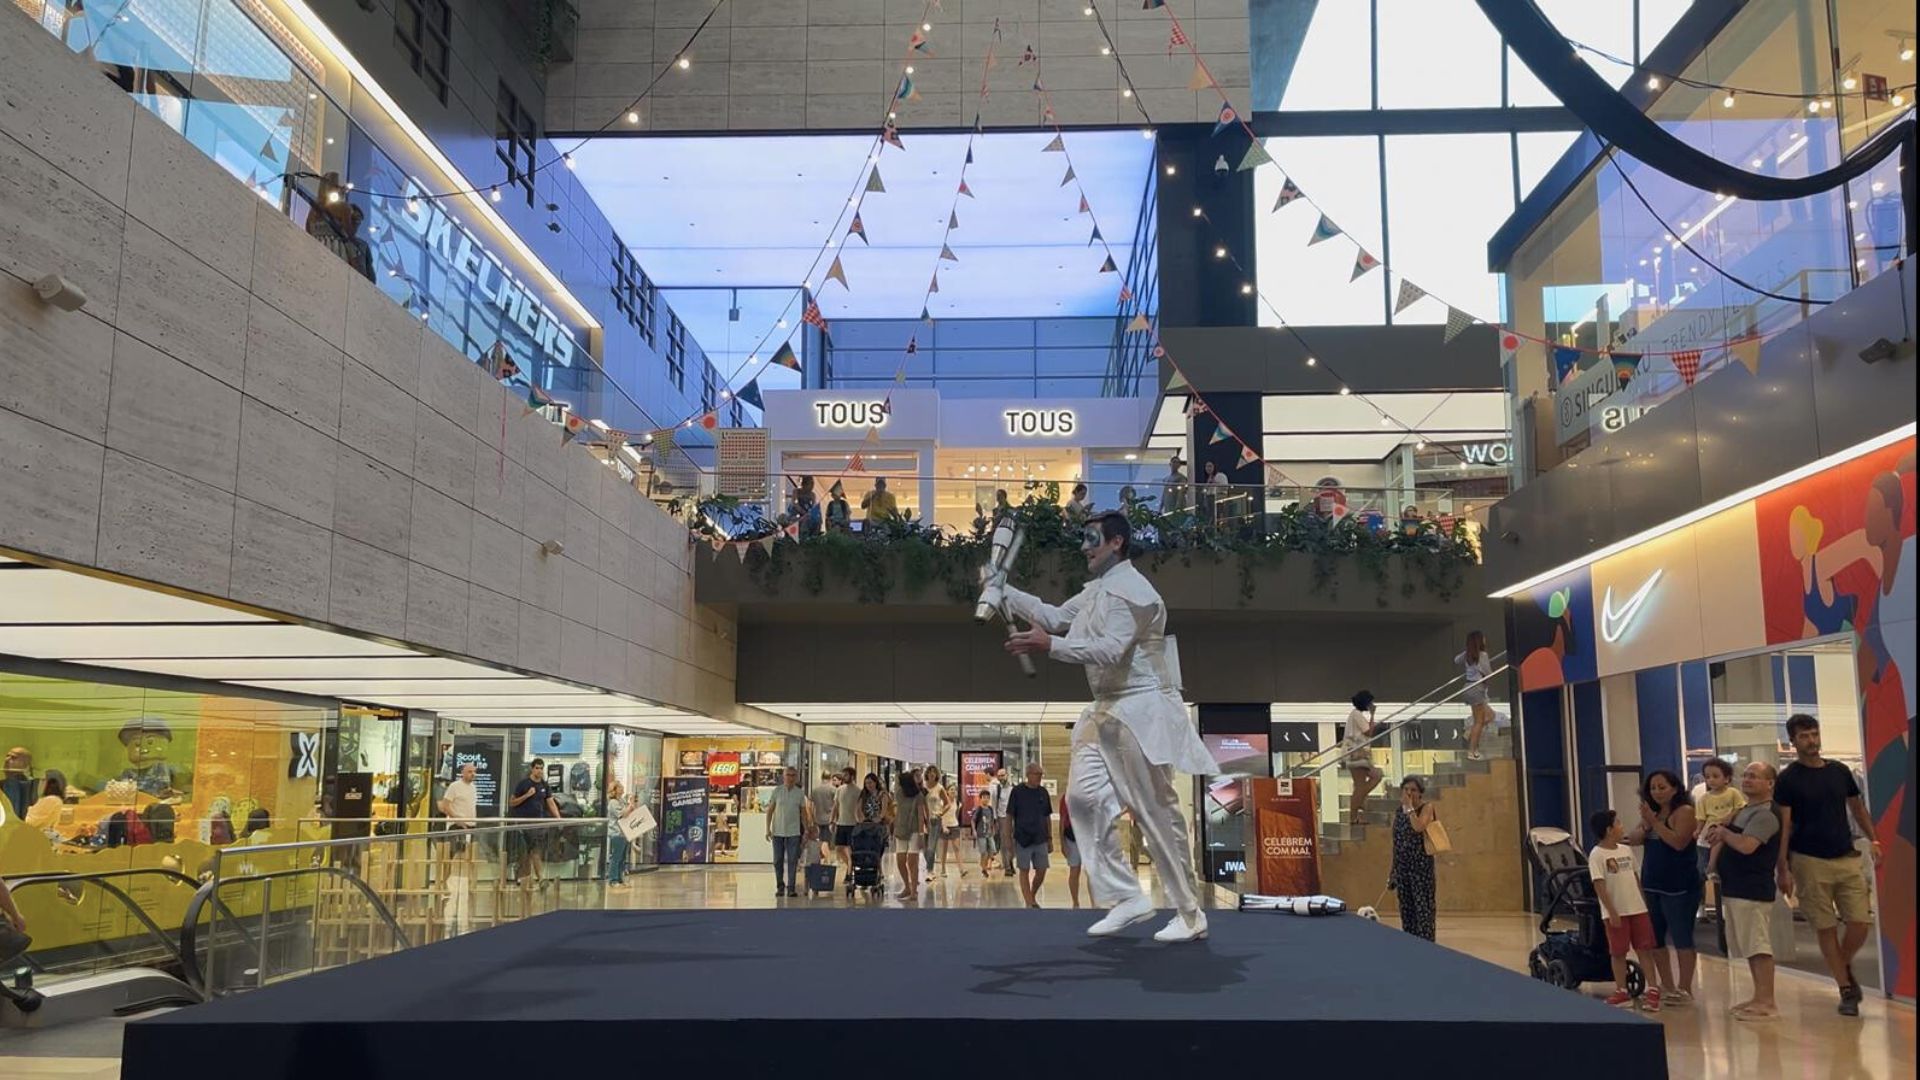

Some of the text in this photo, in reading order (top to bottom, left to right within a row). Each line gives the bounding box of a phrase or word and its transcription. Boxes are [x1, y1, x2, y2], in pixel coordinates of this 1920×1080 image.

[402, 176, 574, 367] SKECHERS
[815, 402, 885, 425] TOUS
[1005, 411, 1074, 433] TOUS
[1463, 443, 1513, 463] WO
[711, 762, 738, 775] LEGO
[1263, 837, 1312, 847] CELEBREM
[1266, 847, 1289, 855] COM
